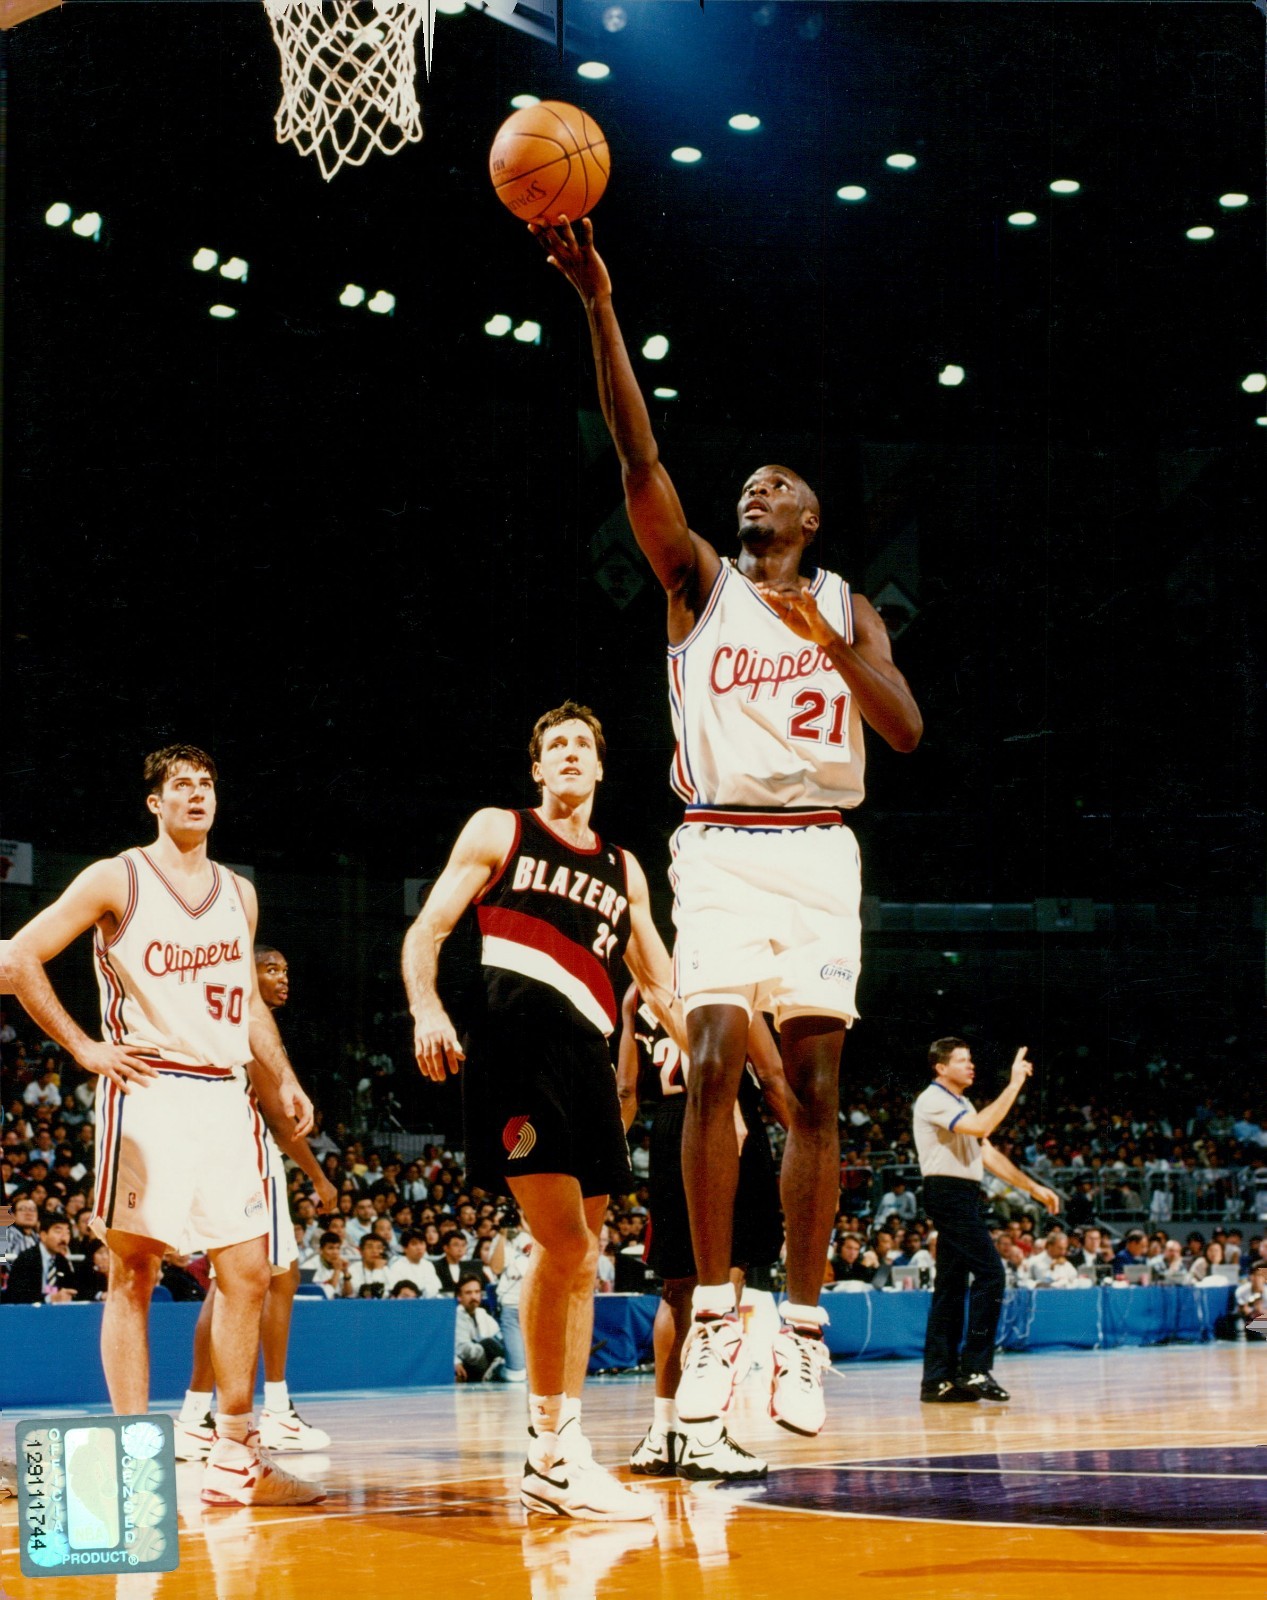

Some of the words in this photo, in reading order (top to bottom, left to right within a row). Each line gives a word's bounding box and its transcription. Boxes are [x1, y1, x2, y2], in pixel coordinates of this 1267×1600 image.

[708, 642, 837, 702] Clipper
[787, 687, 851, 747] 21
[511, 855, 628, 928] BLAZERS
[143, 936, 243, 985] Clippers
[203, 982, 244, 1027] 50
